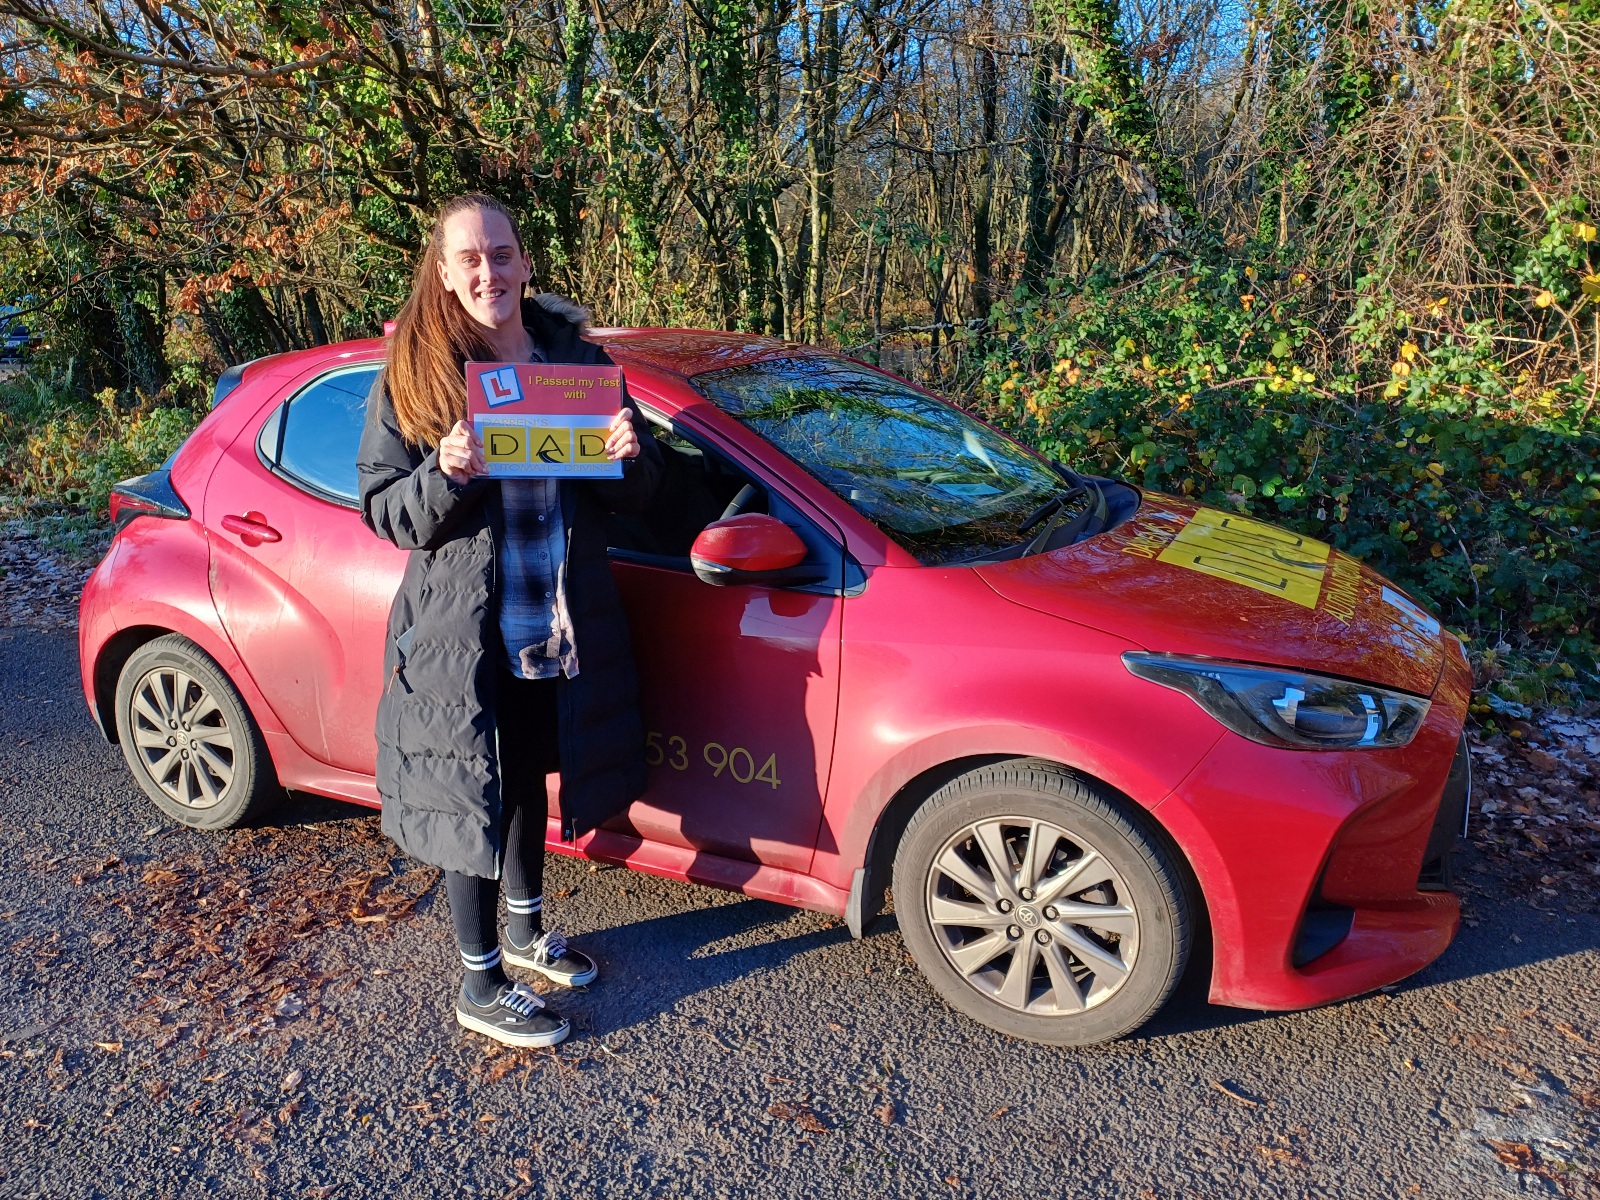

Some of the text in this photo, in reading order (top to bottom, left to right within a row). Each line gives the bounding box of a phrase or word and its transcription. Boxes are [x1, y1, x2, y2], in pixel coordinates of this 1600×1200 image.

[490, 377, 512, 398] L
[528, 375, 620, 389] I Passed my Test
[564, 389, 587, 399] with
[482, 417, 549, 427] DARREN'S
[485, 463, 614, 472] AUTOMATIC DRIVING
[645, 731, 782, 790] 53 904
